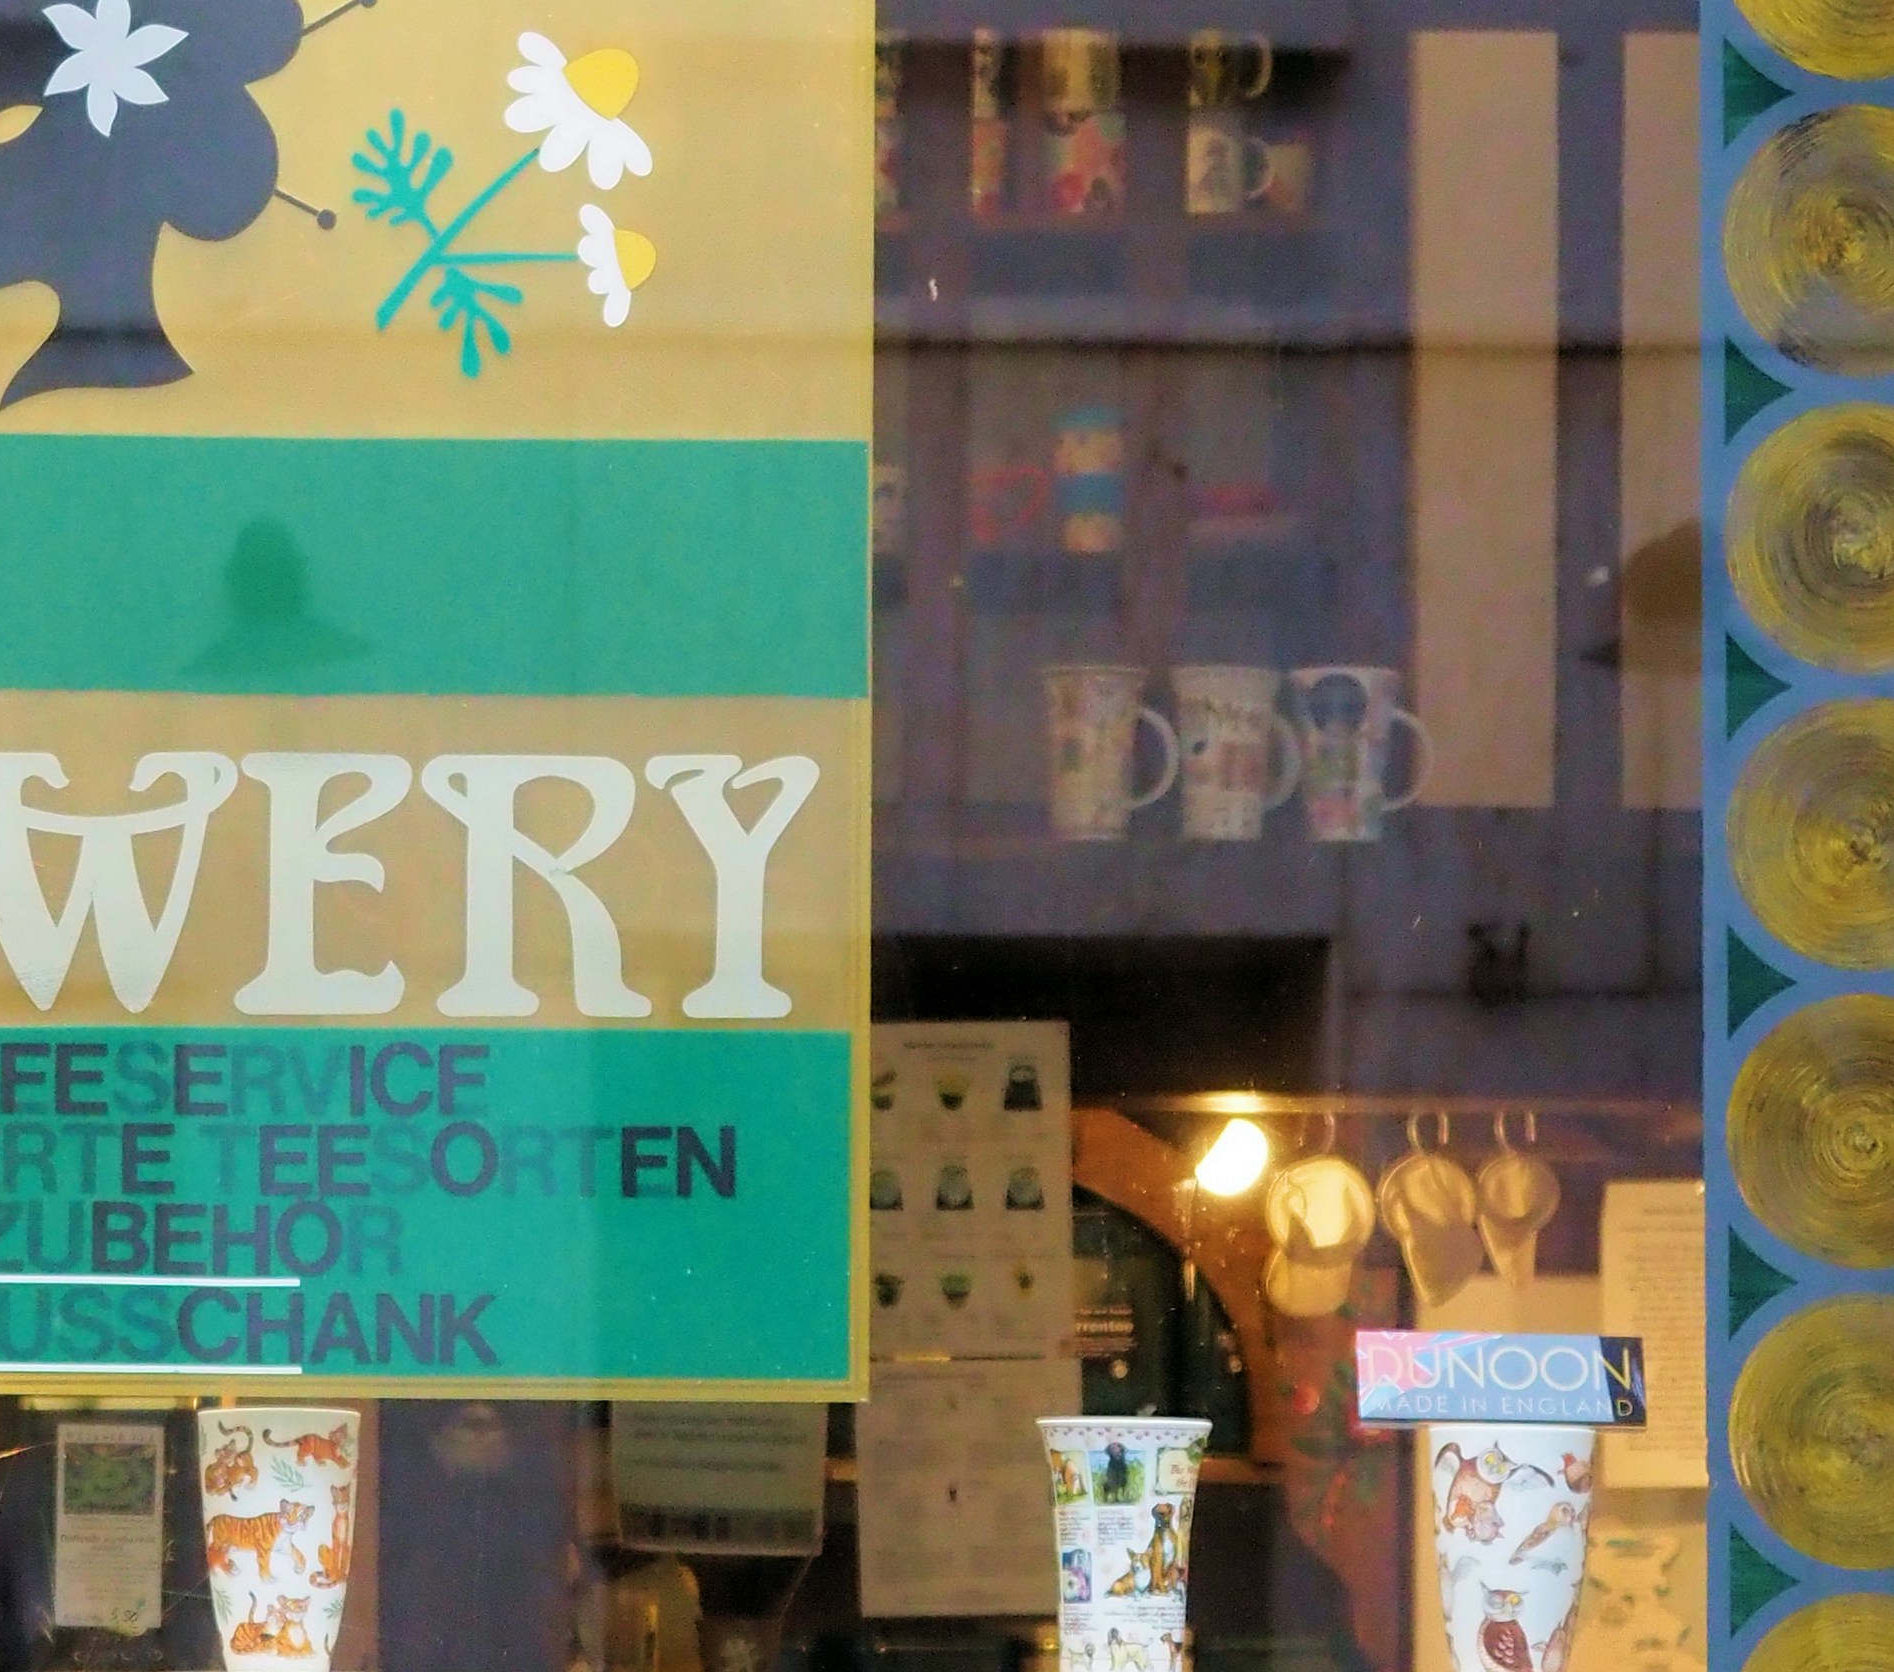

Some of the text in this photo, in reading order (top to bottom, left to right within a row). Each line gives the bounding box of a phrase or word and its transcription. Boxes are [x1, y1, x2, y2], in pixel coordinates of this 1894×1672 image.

[199, 1121, 737, 1198] TEESORTEN
[1365, 1344, 1634, 1391] DUNOON
[1372, 1395, 1634, 1418] MADE IN ENGLAND
